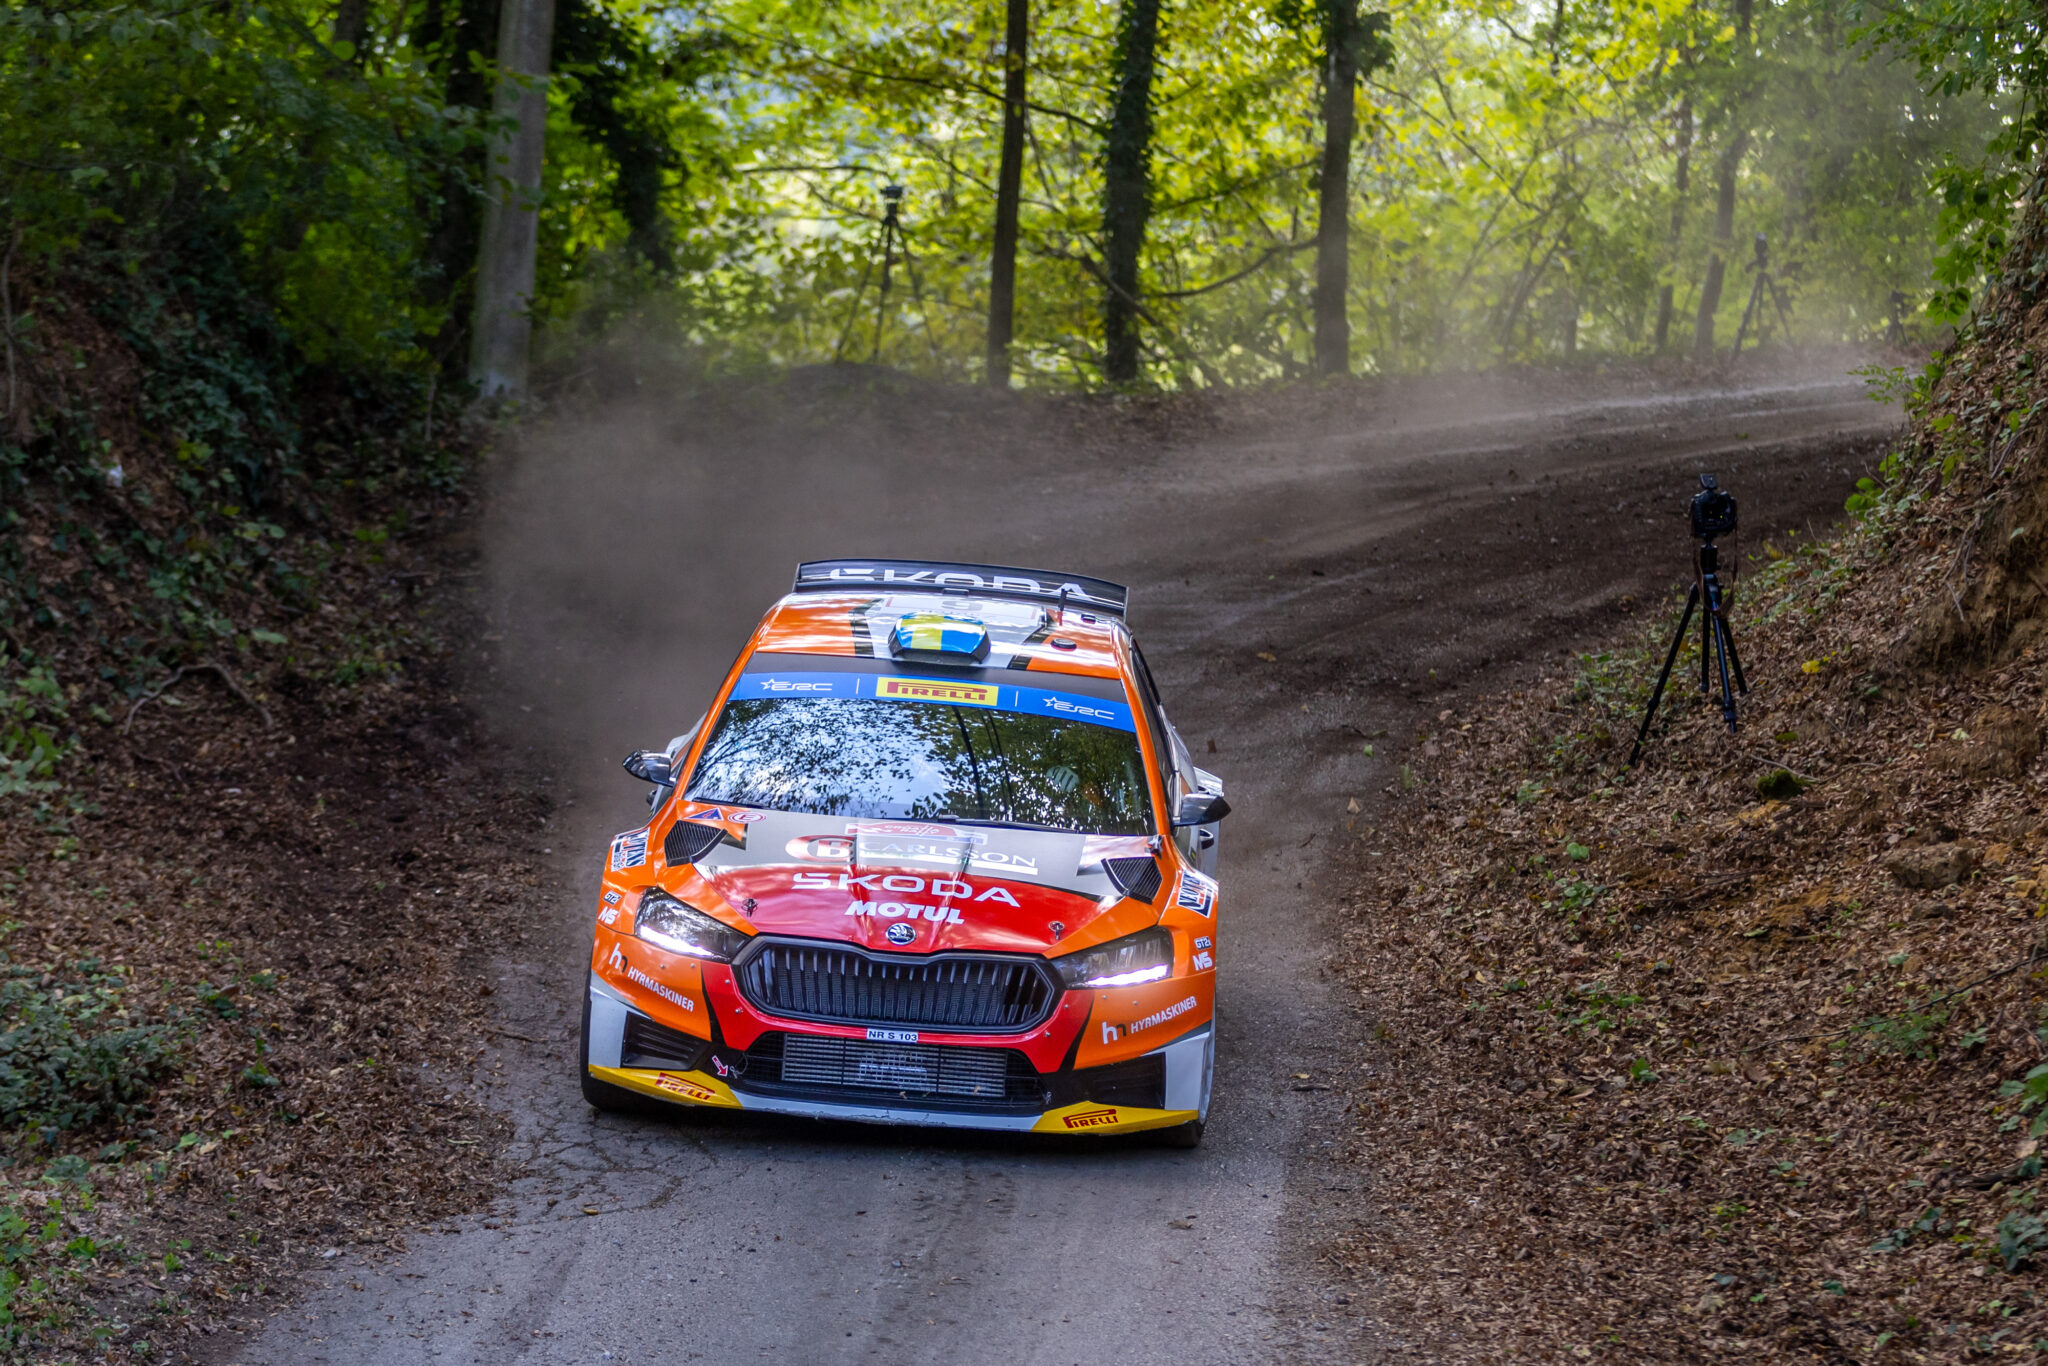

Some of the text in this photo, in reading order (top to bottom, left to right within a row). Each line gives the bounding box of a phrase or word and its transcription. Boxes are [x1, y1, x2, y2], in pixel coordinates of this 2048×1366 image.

[764, 681, 833, 691] ERC
[887, 682, 988, 701] PIRELLI
[1048, 699, 1115, 720] ERC
[860, 840, 1037, 867] CARLSSON
[844, 901, 965, 924] MOTUL
[628, 966, 694, 1012] HYRMASKINER
[1130, 995, 1197, 1034] HYRMASKINER
[900, 1033, 917, 1041] 103
[655, 1072, 715, 1100] PIRELLI
[1062, 1108, 1118, 1128] PIRELLI
